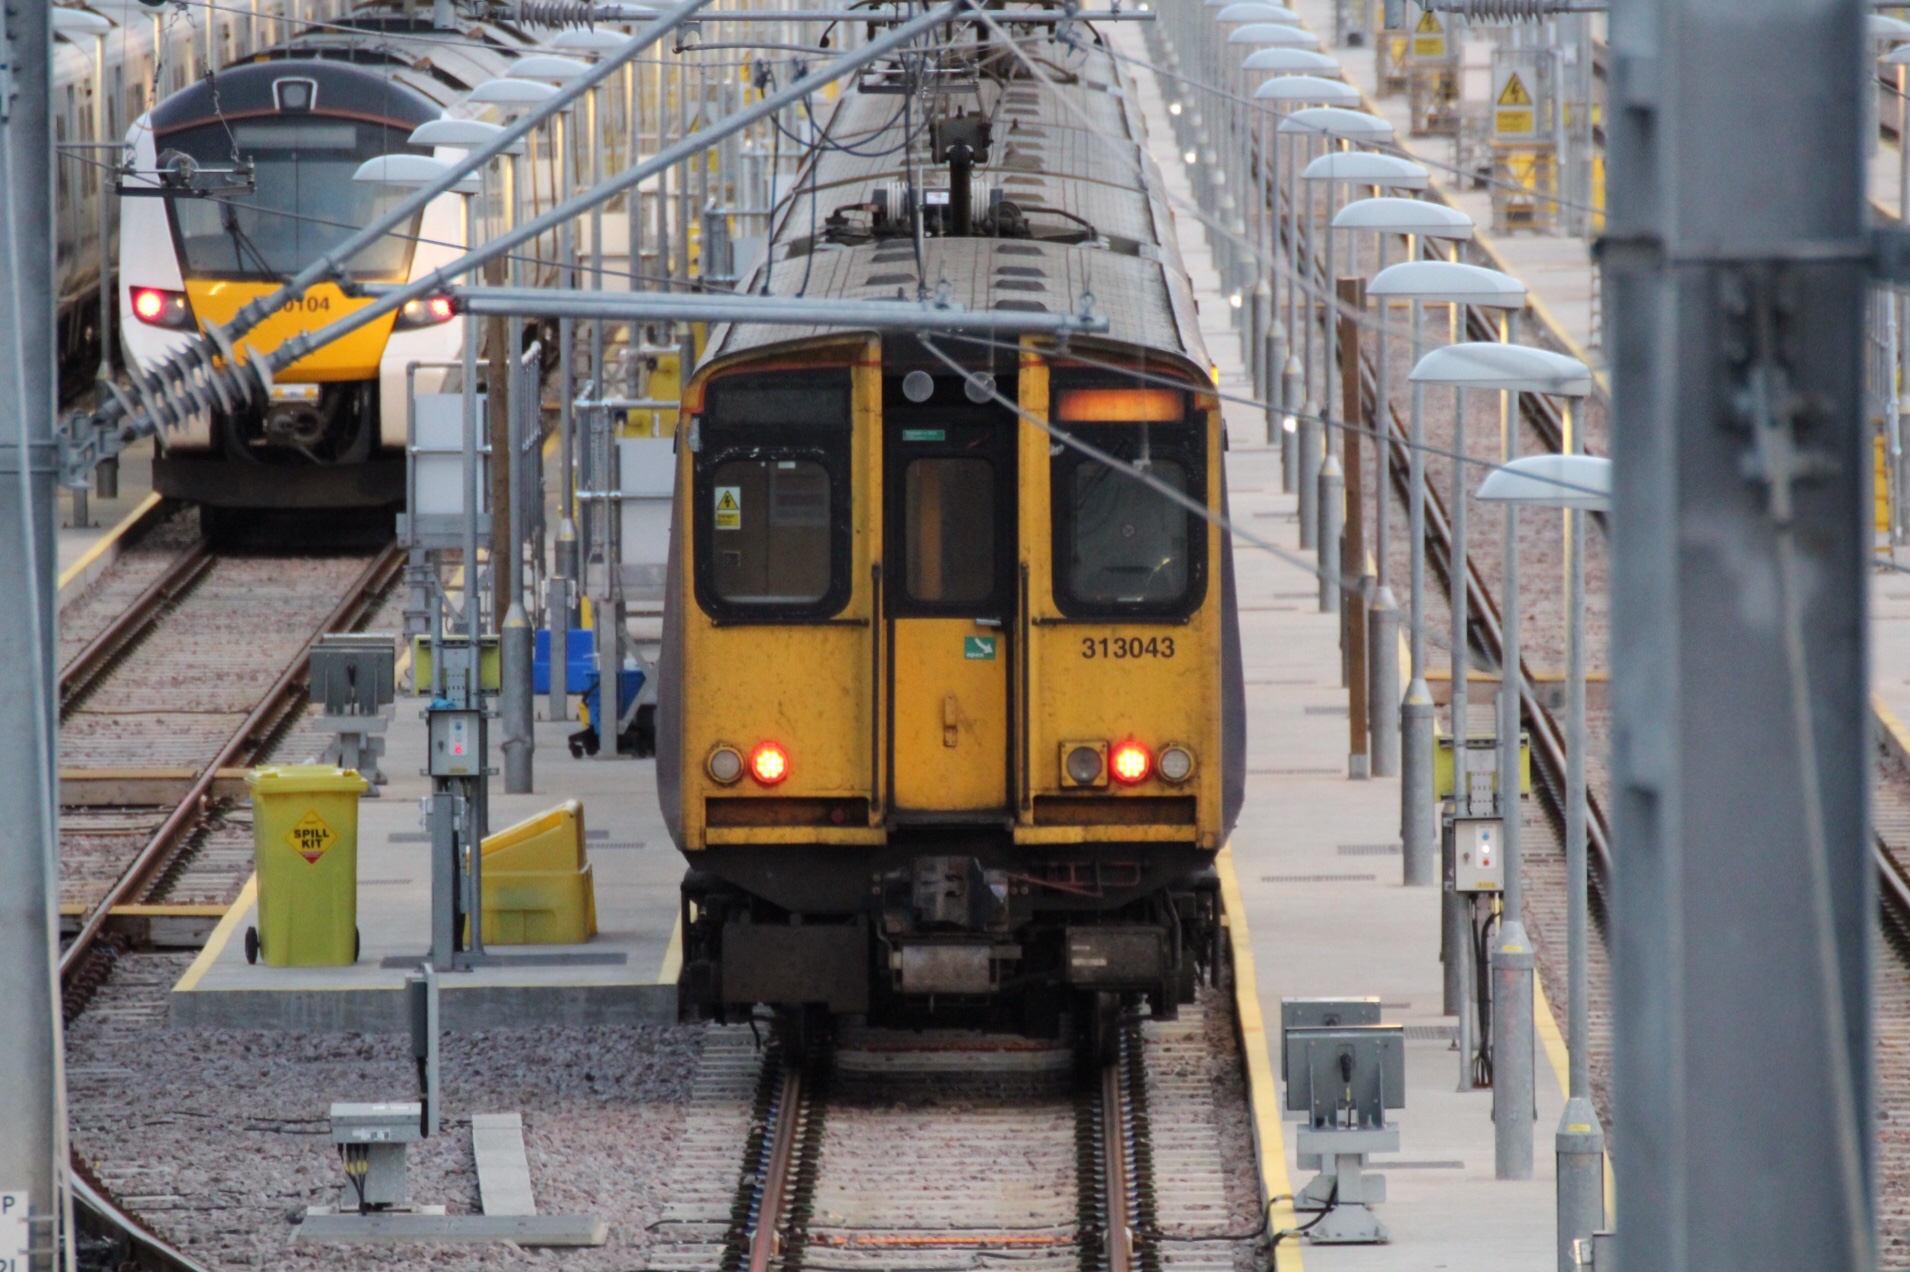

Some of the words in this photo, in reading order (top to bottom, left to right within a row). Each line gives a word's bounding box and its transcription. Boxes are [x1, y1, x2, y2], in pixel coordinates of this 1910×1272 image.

[282, 297, 330, 312] 0104
[1082, 637, 1175, 659] 313043
[294, 828, 330, 839] SPILL
[302, 838, 323, 849] KIT
